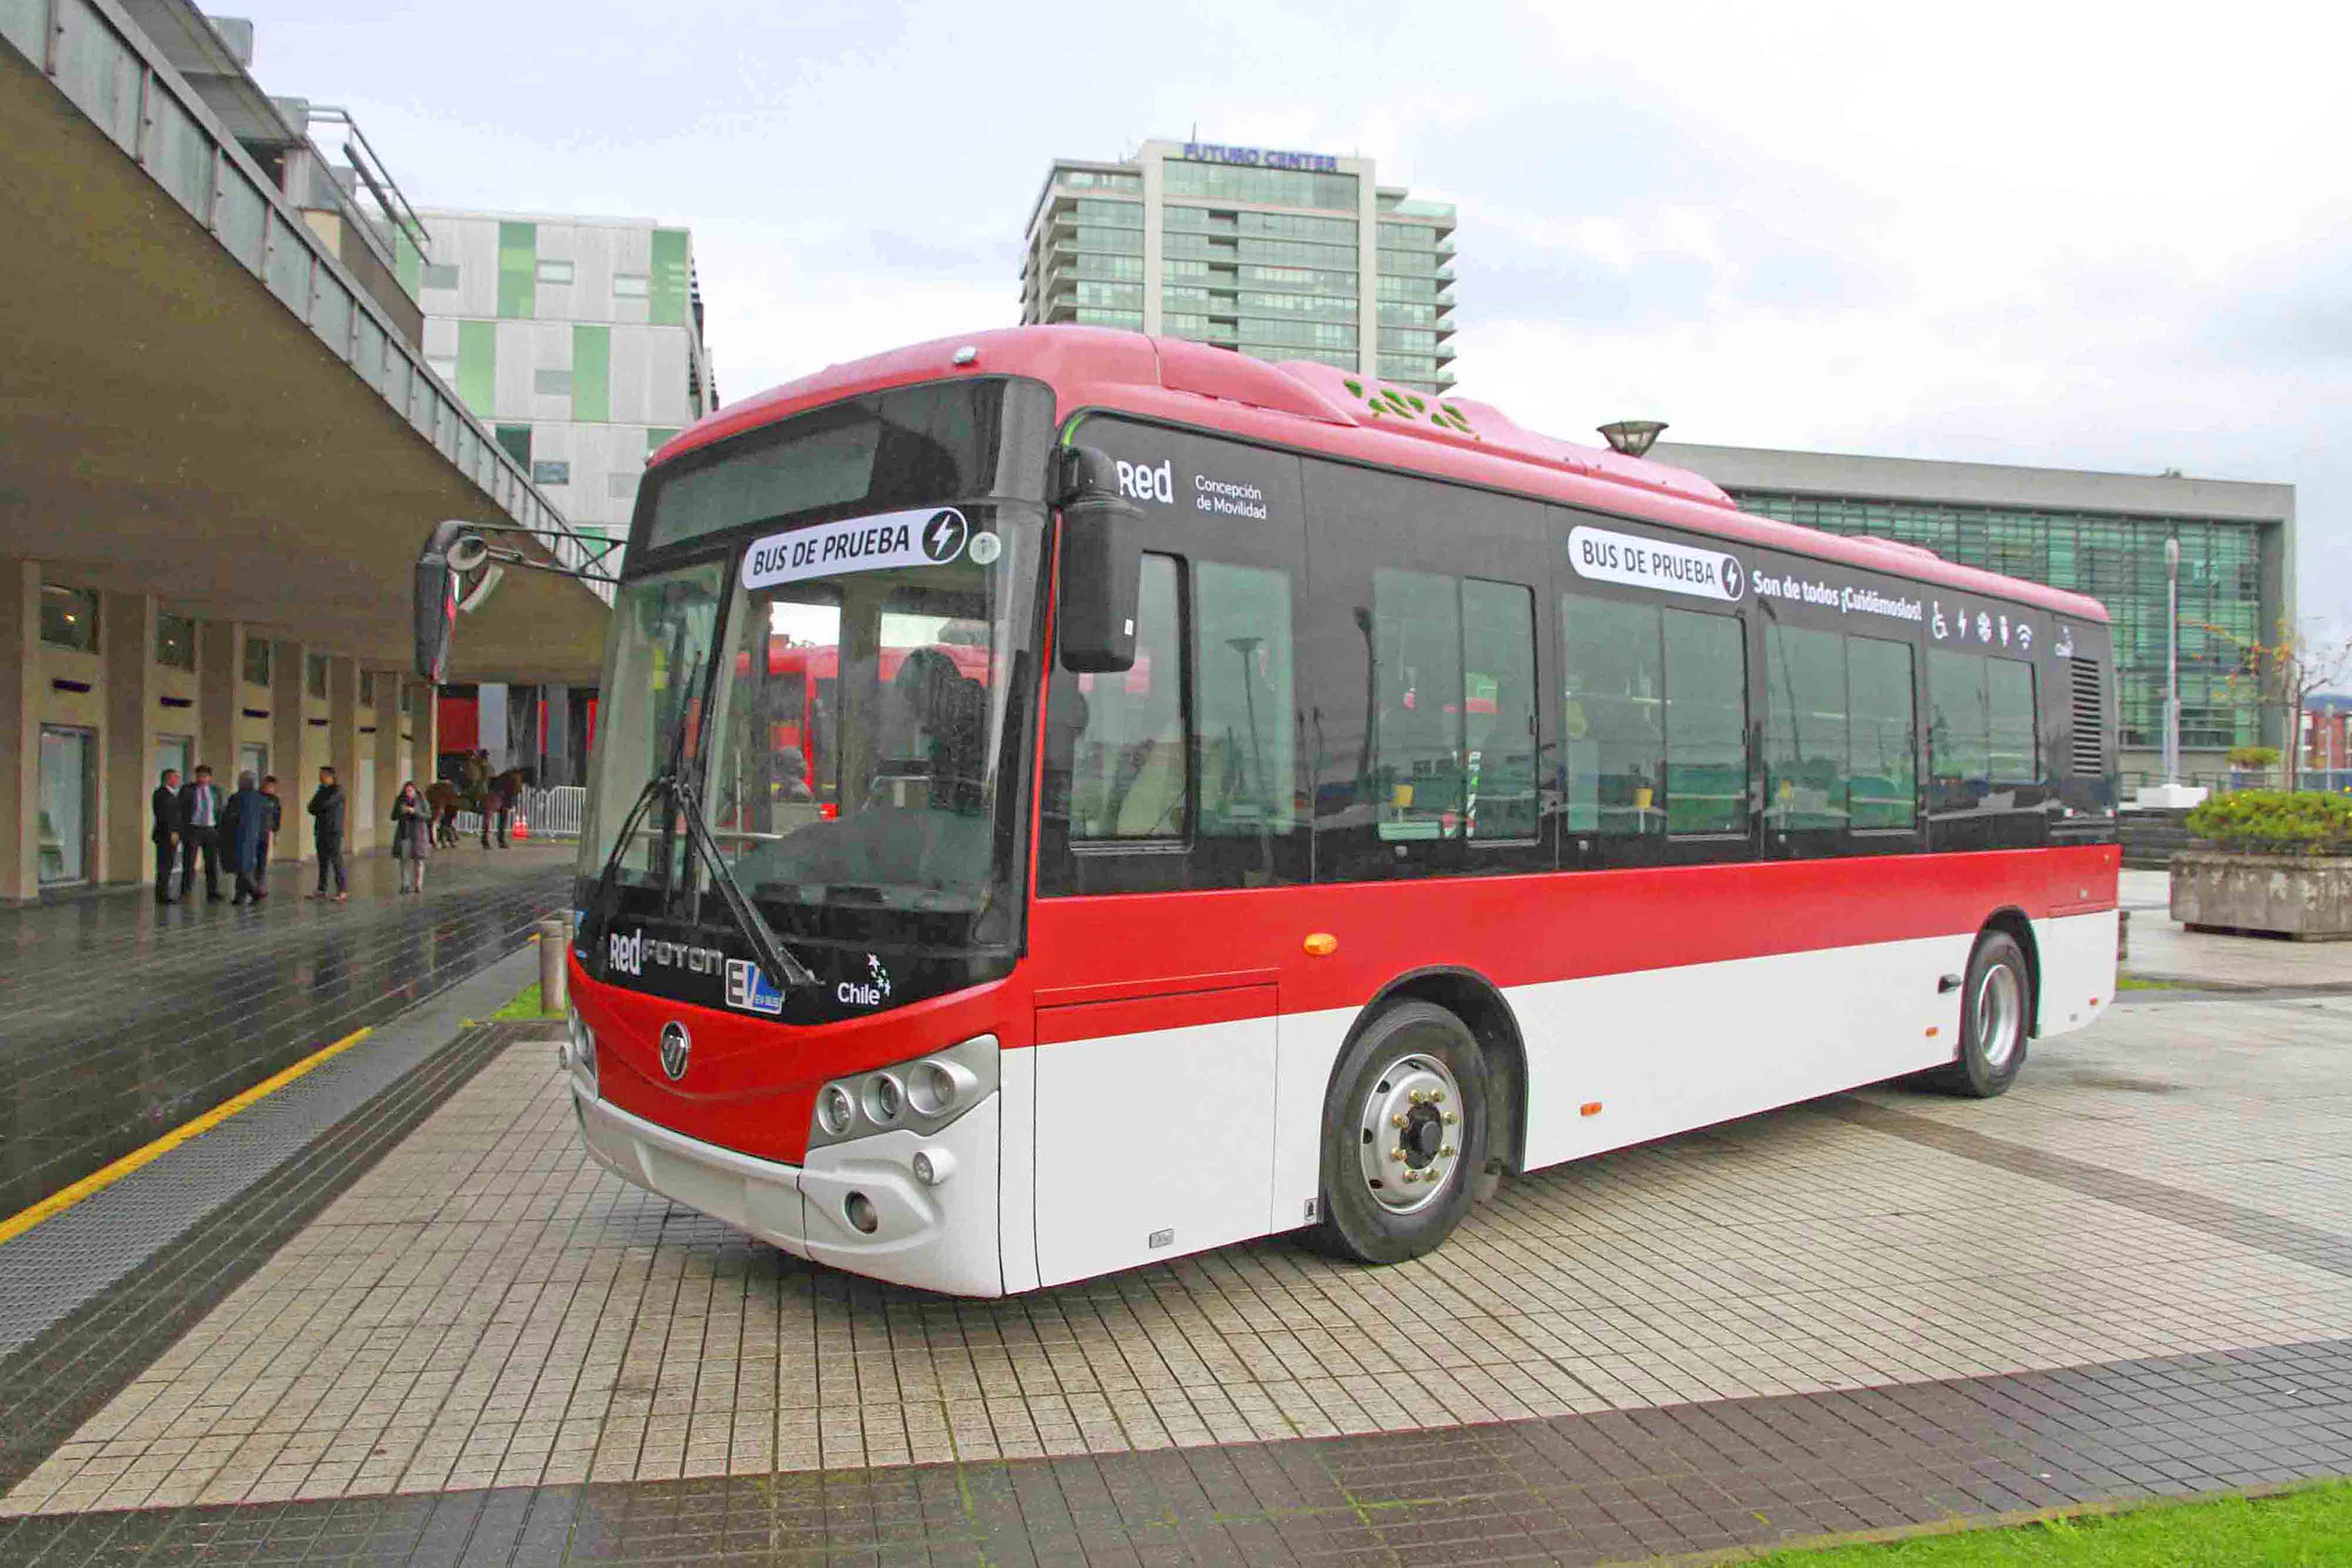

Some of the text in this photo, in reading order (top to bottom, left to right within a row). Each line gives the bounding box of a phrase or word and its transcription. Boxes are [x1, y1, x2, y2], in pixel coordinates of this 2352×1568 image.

[1184, 143, 1337, 171] FUTURO CENTER
[1117, 460, 1174, 504] Red
[1195, 475, 1261, 500] Concepción
[1197, 494, 1267, 519] de Movilidad
[753, 524, 910, 576] BUS DE PRUEBA
[1583, 540, 1716, 586] BUS DE PRUEBA
[1752, 570, 1781, 597] Son
[1783, 576, 1801, 600] de
[1802, 581, 1839, 606] todos
[610, 928, 642, 976] Red
[838, 982, 880, 1005] Chile
